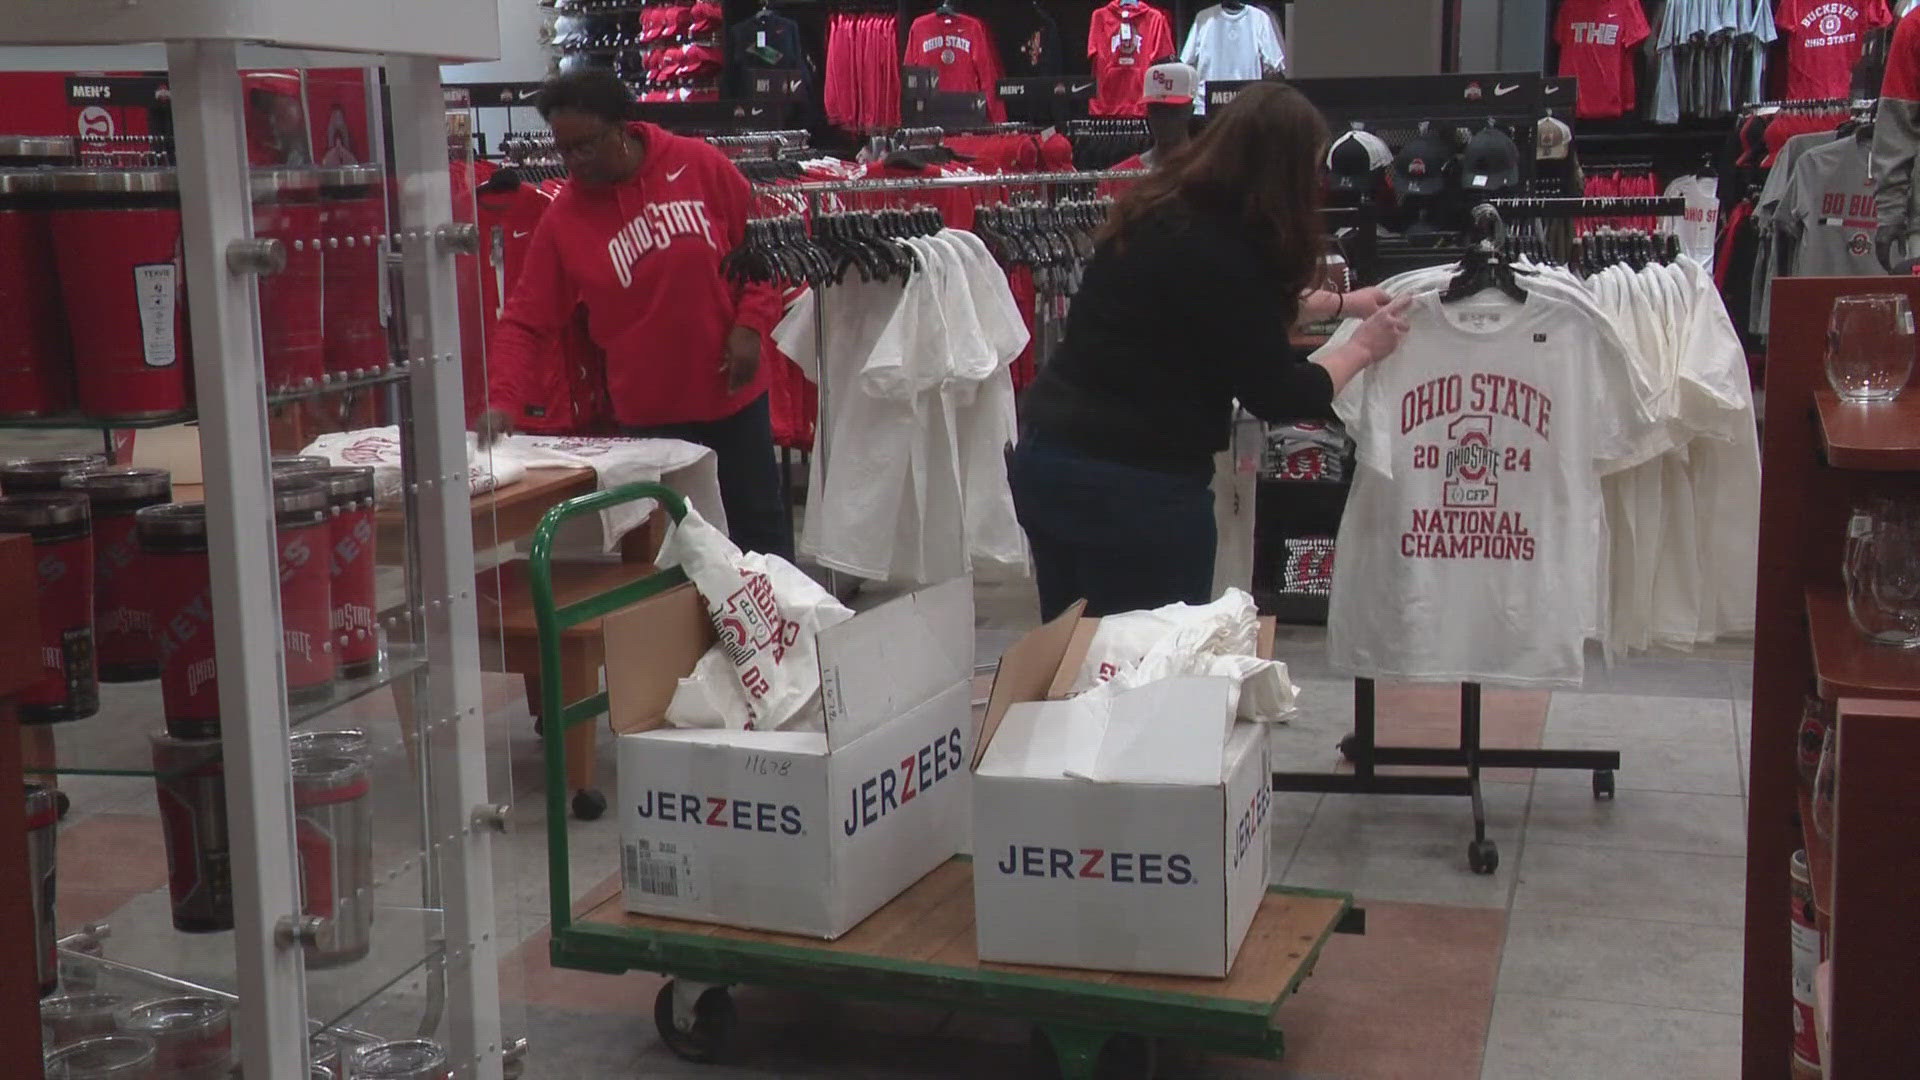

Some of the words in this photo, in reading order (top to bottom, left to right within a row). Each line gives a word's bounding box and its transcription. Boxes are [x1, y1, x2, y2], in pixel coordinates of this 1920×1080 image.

[1801, 3, 1859, 28] BUCKEYES
[923, 36, 943, 53] OHIO
[945, 35, 971, 53] STATE
[1571, 22, 1619, 45] THE
[73, 86, 111, 98] MEN'S
[1401, 374, 1462, 435] OHIO
[1470, 373, 1552, 442] STATE
[1413, 444, 1440, 469] 20
[1504, 447, 1532, 472] 24
[1466, 488, 1490, 501] CFP
[1411, 509, 1528, 535] NATIONAL
[1401, 533, 1536, 561] CHAMPIONS
[844, 727, 963, 837] JERZEES
[637, 790, 803, 836] JERZEES
[1233, 784, 1271, 870] JERZEES
[998, 844, 1194, 885] JERZEES
